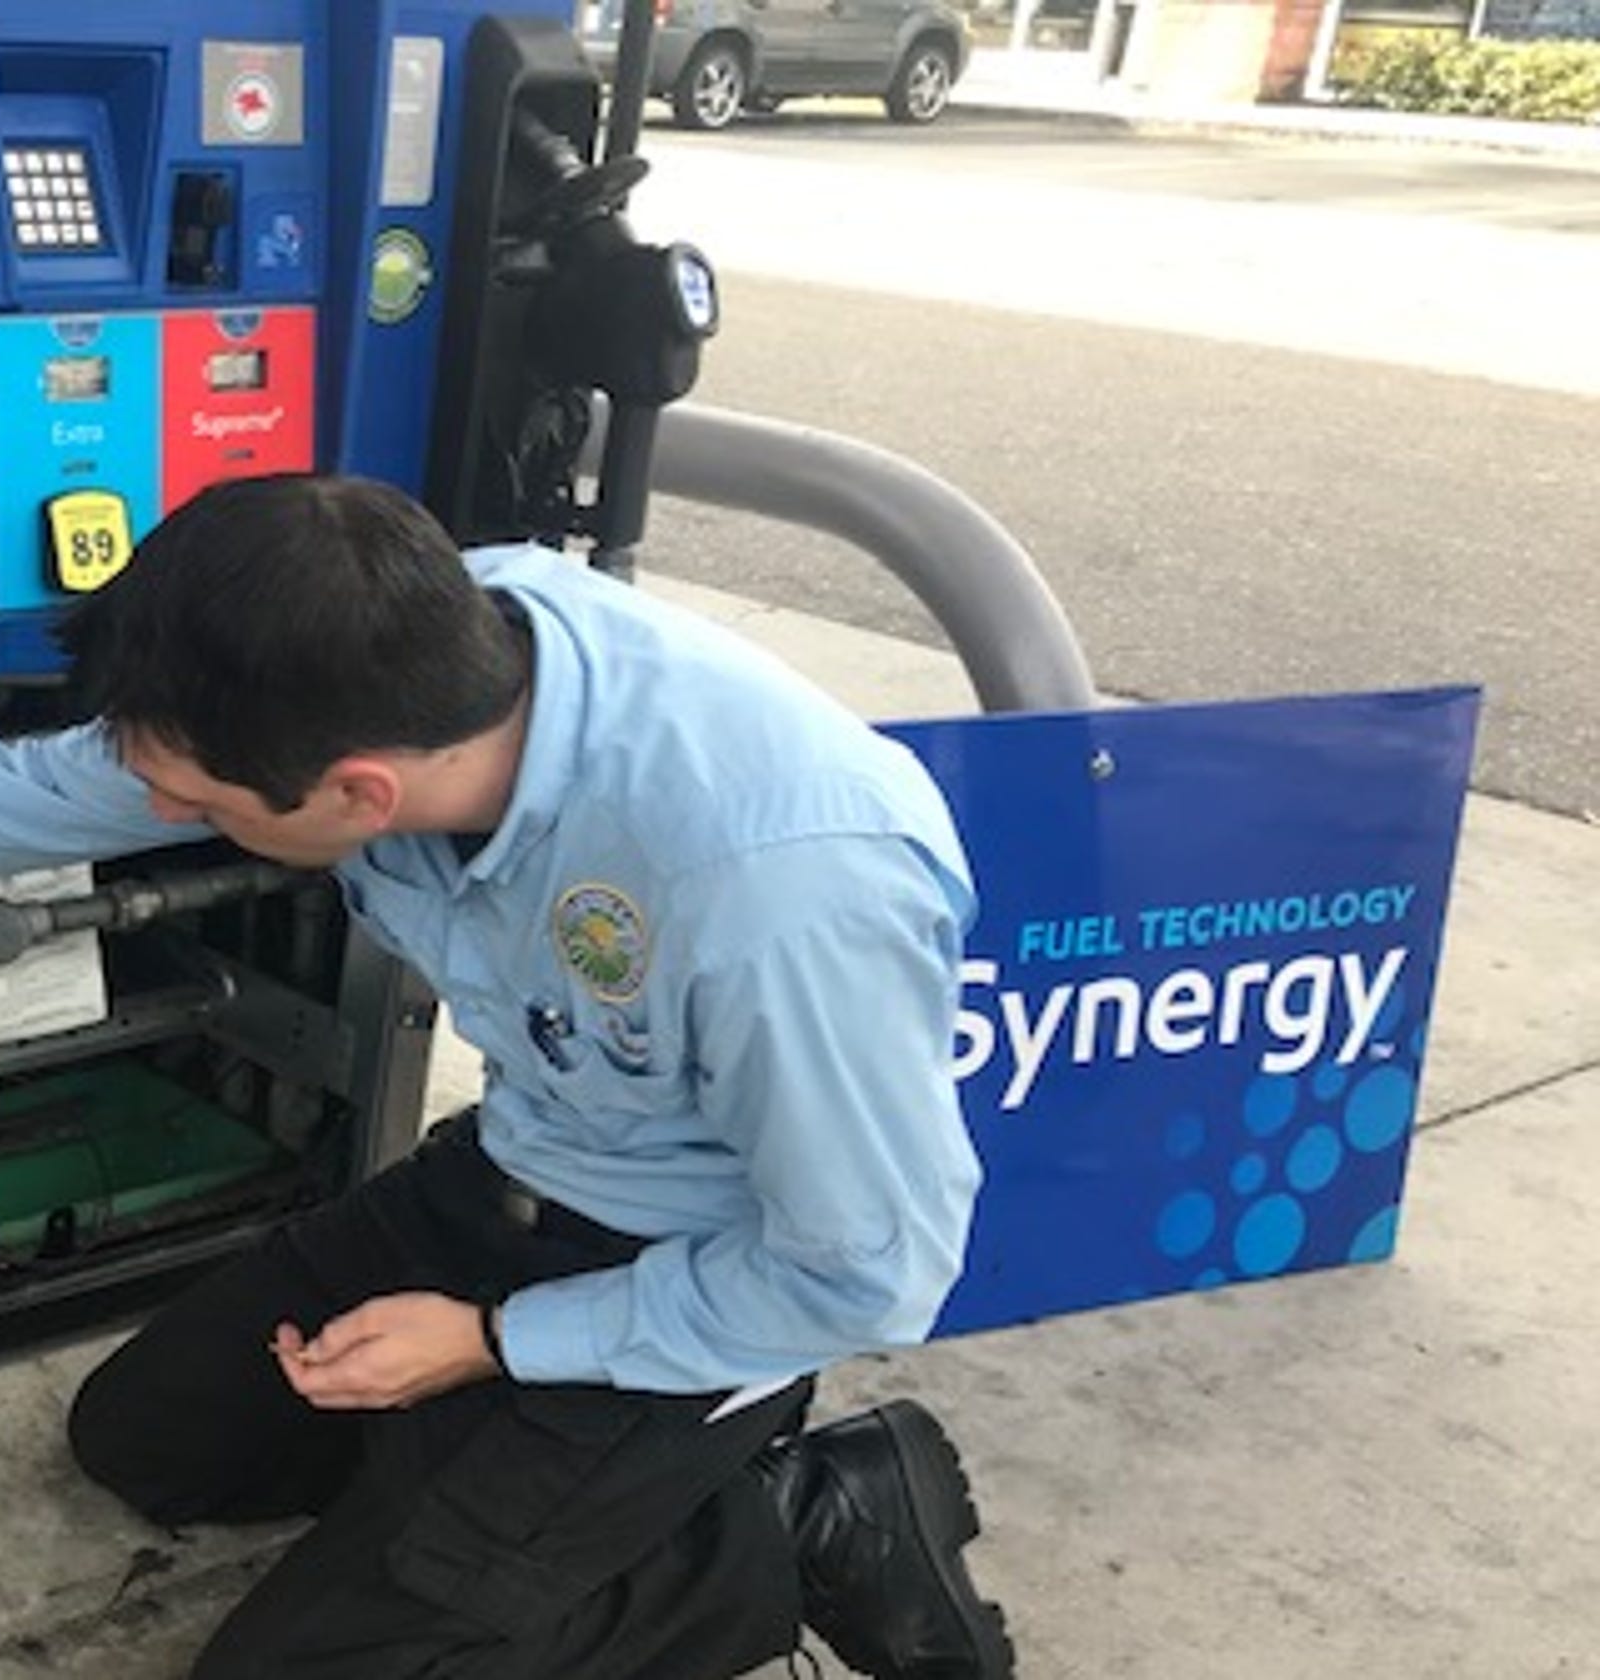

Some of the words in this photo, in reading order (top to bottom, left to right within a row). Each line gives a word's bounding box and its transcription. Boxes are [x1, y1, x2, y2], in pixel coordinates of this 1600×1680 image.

[51, 420, 105, 444] Extra
[70, 530, 117, 567] 89
[1017, 916, 1124, 963] FUEL
[1138, 885, 1416, 950] TECHNOLOGY
[952, 947, 1408, 1111] Synergy
